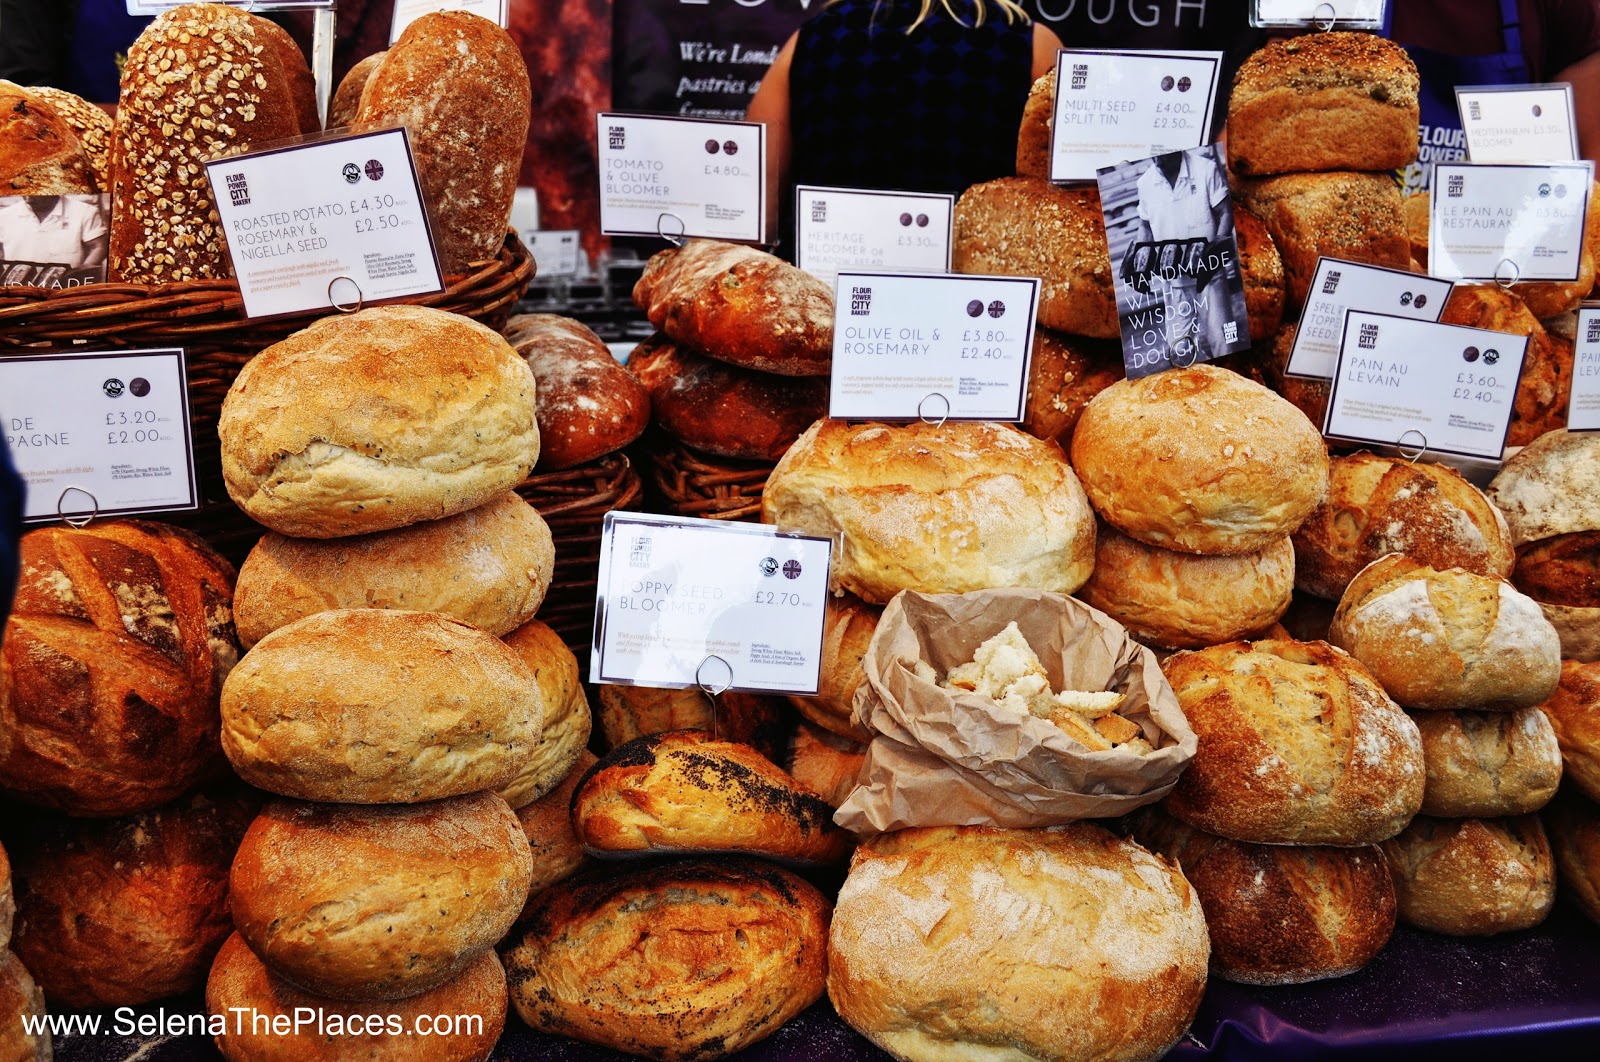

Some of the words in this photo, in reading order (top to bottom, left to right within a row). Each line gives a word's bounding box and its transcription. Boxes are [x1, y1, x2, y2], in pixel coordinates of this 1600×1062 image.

[680, 42, 725, 63] We're
[676, 74, 744, 98] pastries
[1072, 76, 1086, 84] CITY
[1066, 100, 1102, 110] MULTI
[1107, 101, 1136, 111] SEED
[1156, 102, 1189, 113] £4.00
[1065, 113, 1094, 124] SPLIT
[1100, 115, 1118, 124] TIN
[1154, 118, 1186, 128] £2.50
[606, 159, 663, 170] TOMATO
[705, 165, 740, 176] £4.80
[226, 173, 245, 183] FLOUR
[607, 171, 613, 180] &
[620, 172, 658, 183] OLIVE
[228, 181, 247, 190] POWER
[606, 184, 669, 196] BLOOMER
[230, 188, 248, 200] CITY
[233, 198, 250, 206] BAKERY
[351, 195, 393, 213] £4.30
[234, 212, 290, 231] ROASTED
[294, 204, 346, 221] POTATO,
[1444, 207, 1456, 216] LE
[1464, 207, 1491, 216] PAIN
[1497, 208, 1512, 216] AU
[356, 215, 398, 233] £2.50
[238, 225, 304, 246] ROSEMARY
[310, 223, 316, 234] &
[808, 232, 864, 243] HERITAGE
[242, 243, 295, 260] NIGELLA
[298, 237, 327, 252] SEED
[808, 243, 865, 255] BLOOMER
[808, 256, 850, 264] MEADOW
[1123, 251, 1232, 292] HANDMADE
[1324, 282, 1338, 290] CITY
[1126, 287, 1173, 310] WITH
[852, 301, 870, 309] CITY
[1128, 297, 1208, 330] WISDOM
[846, 327, 892, 339] OLIVE
[900, 328, 923, 340] OIL
[933, 328, 940, 340] &
[963, 330, 1004, 342] £3.80
[1131, 323, 1183, 350] LOVE
[1192, 317, 1200, 333] &
[1225, 332, 1237, 340] CITY
[1306, 327, 1337, 340] SEEDS
[1360, 335, 1376, 344] CITY
[845, 343, 930, 355] ROSEMARY
[962, 348, 1001, 359] £2.40
[1351, 357, 1383, 371] PAIN
[1389, 363, 1408, 374] AU
[1349, 371, 1400, 387] LEVAIN
[1457, 373, 1496, 387] £3.60
[1454, 388, 1492, 402] £2.40
[106, 411, 155, 425] £3.20
[12, 418, 34, 431] DE
[108, 429, 158, 444] £2.00
[631, 544, 651, 552] POWER
[630, 552, 650, 562] CITY
[628, 581, 672, 594] OPPY
[682, 585, 722, 599] SEED
[755, 591, 799, 606] £2.70
[621, 596, 706, 614] BLOOMER
